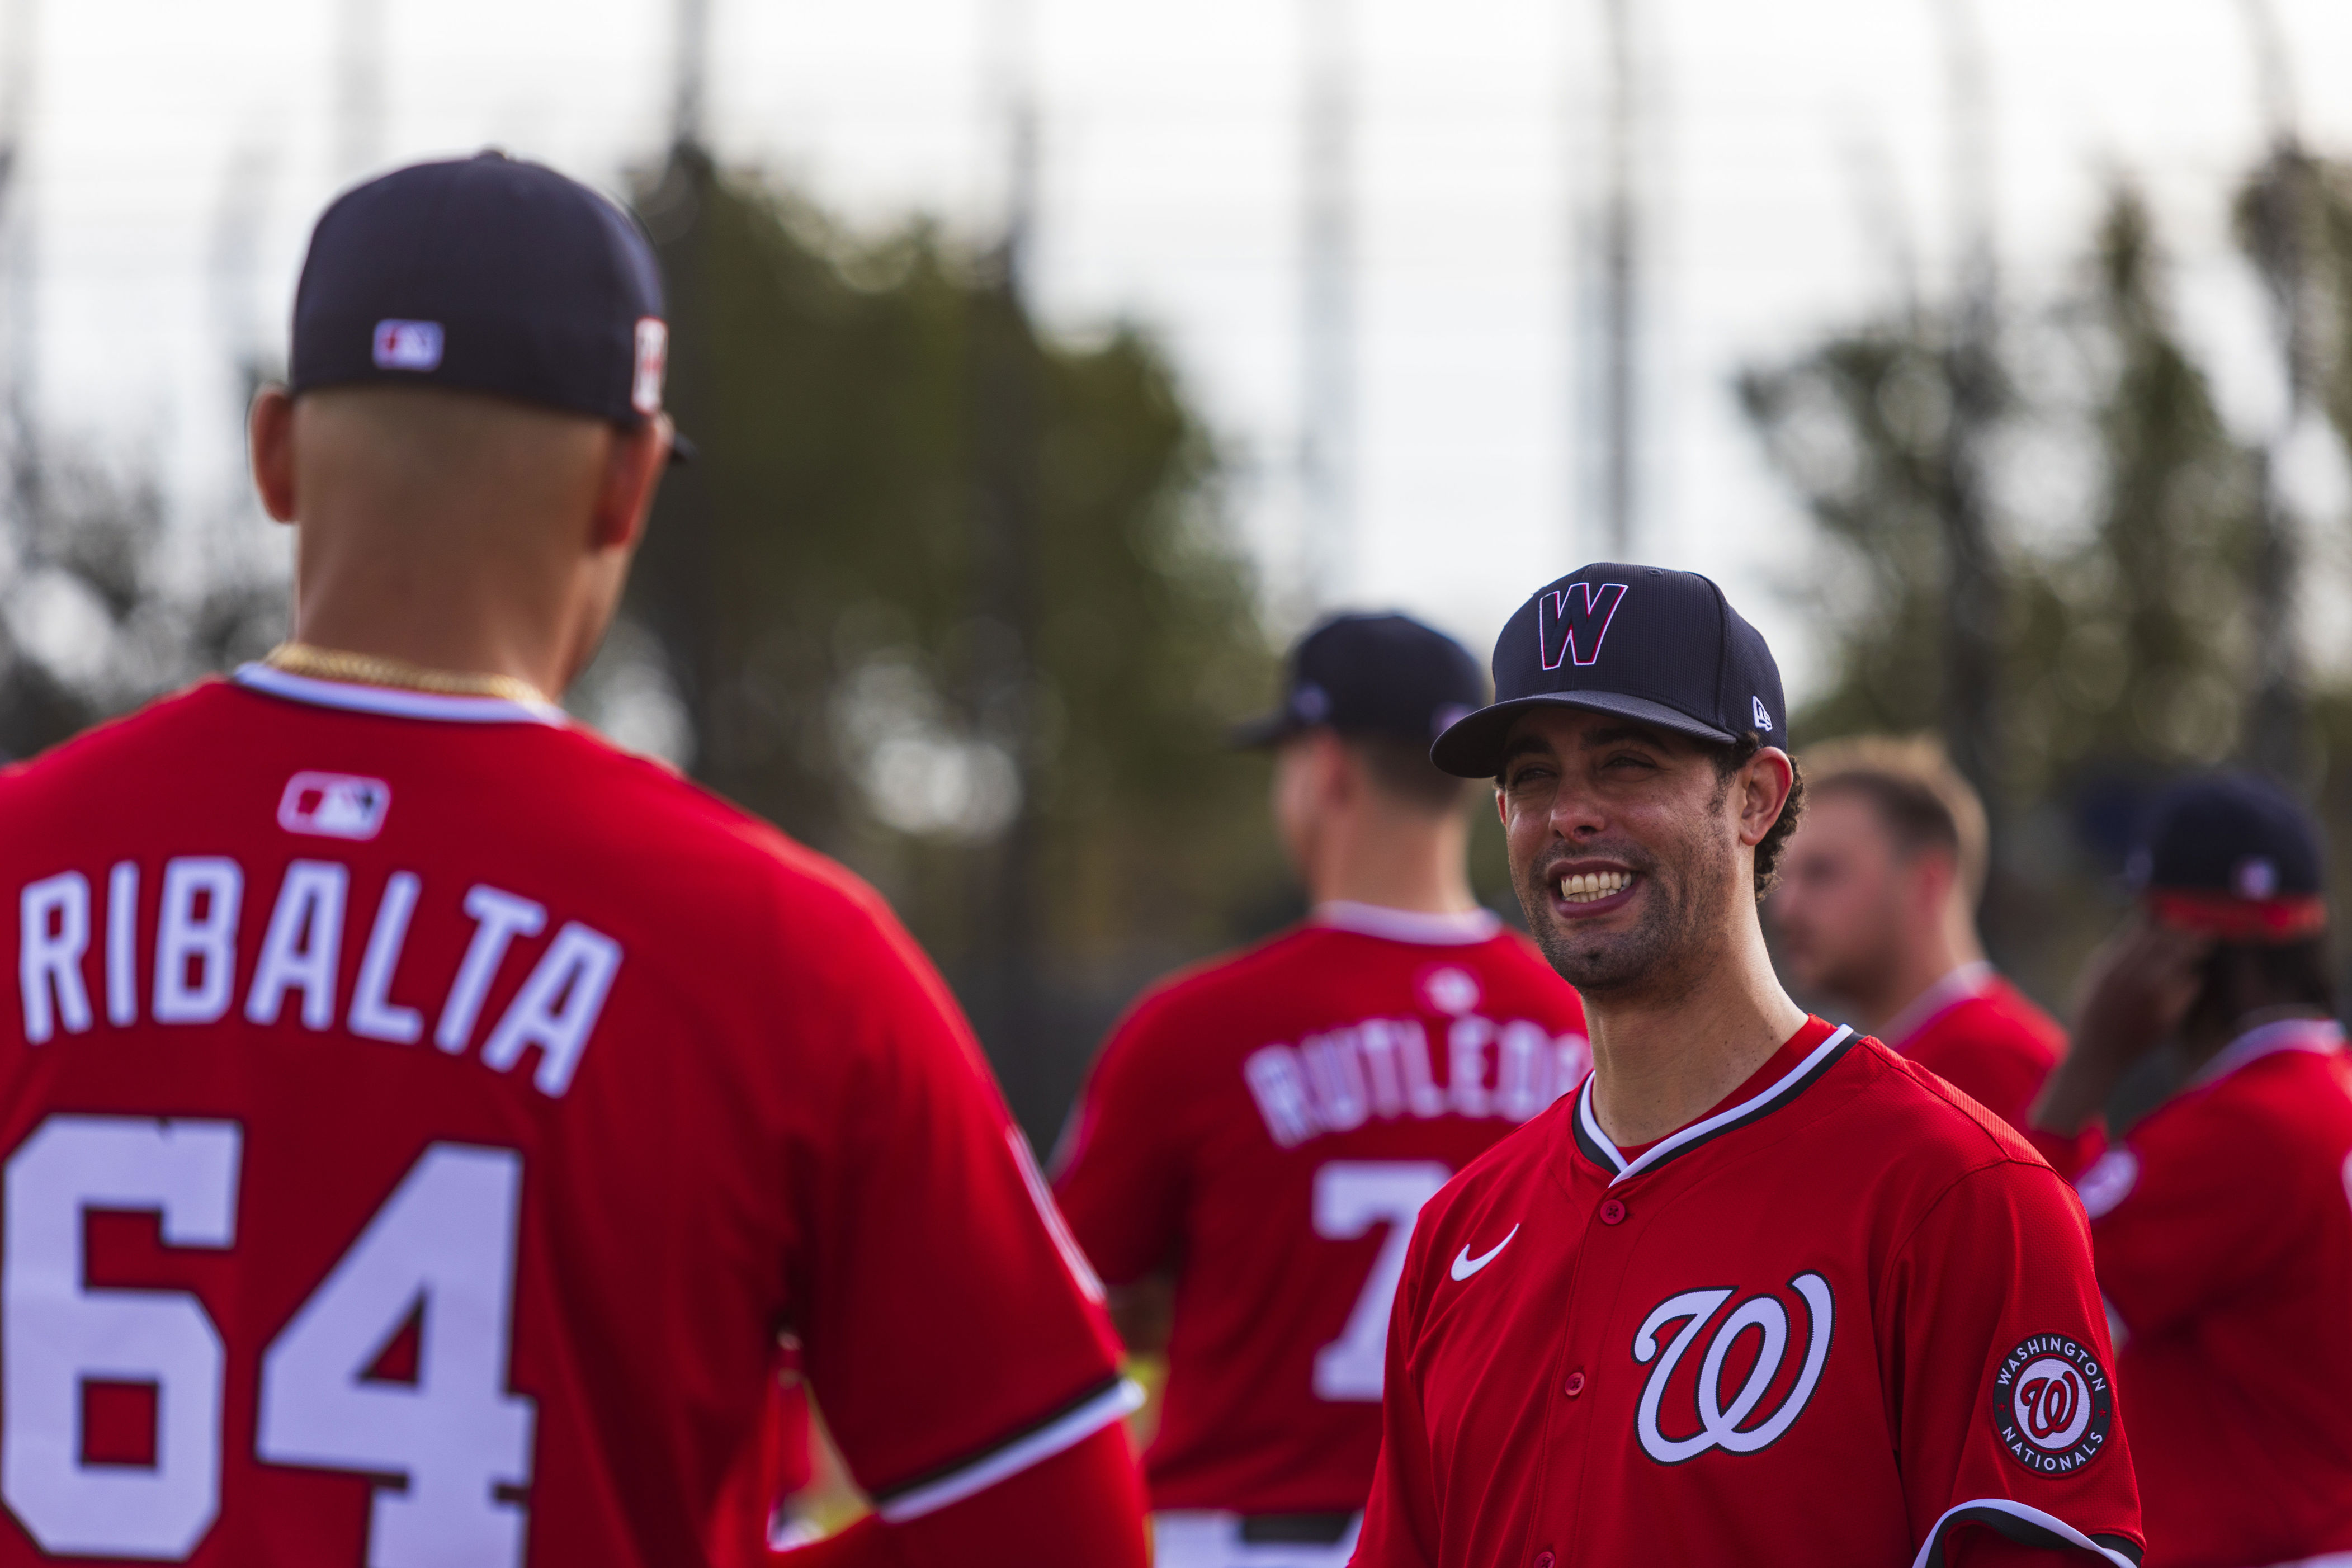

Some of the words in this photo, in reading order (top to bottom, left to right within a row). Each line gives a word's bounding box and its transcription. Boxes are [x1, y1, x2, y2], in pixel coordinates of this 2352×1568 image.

[1539, 582, 1628, 670] W
[18, 854, 624, 1099] RIBALTA
[0, 1112, 538, 1568] 64
[1630, 1269, 1836, 1466] W
[1997, 1337, 2106, 1391] WASHINGTON
[2002, 1426, 2103, 1471] NATIONALS
[2020, 1370, 2079, 1439] W
